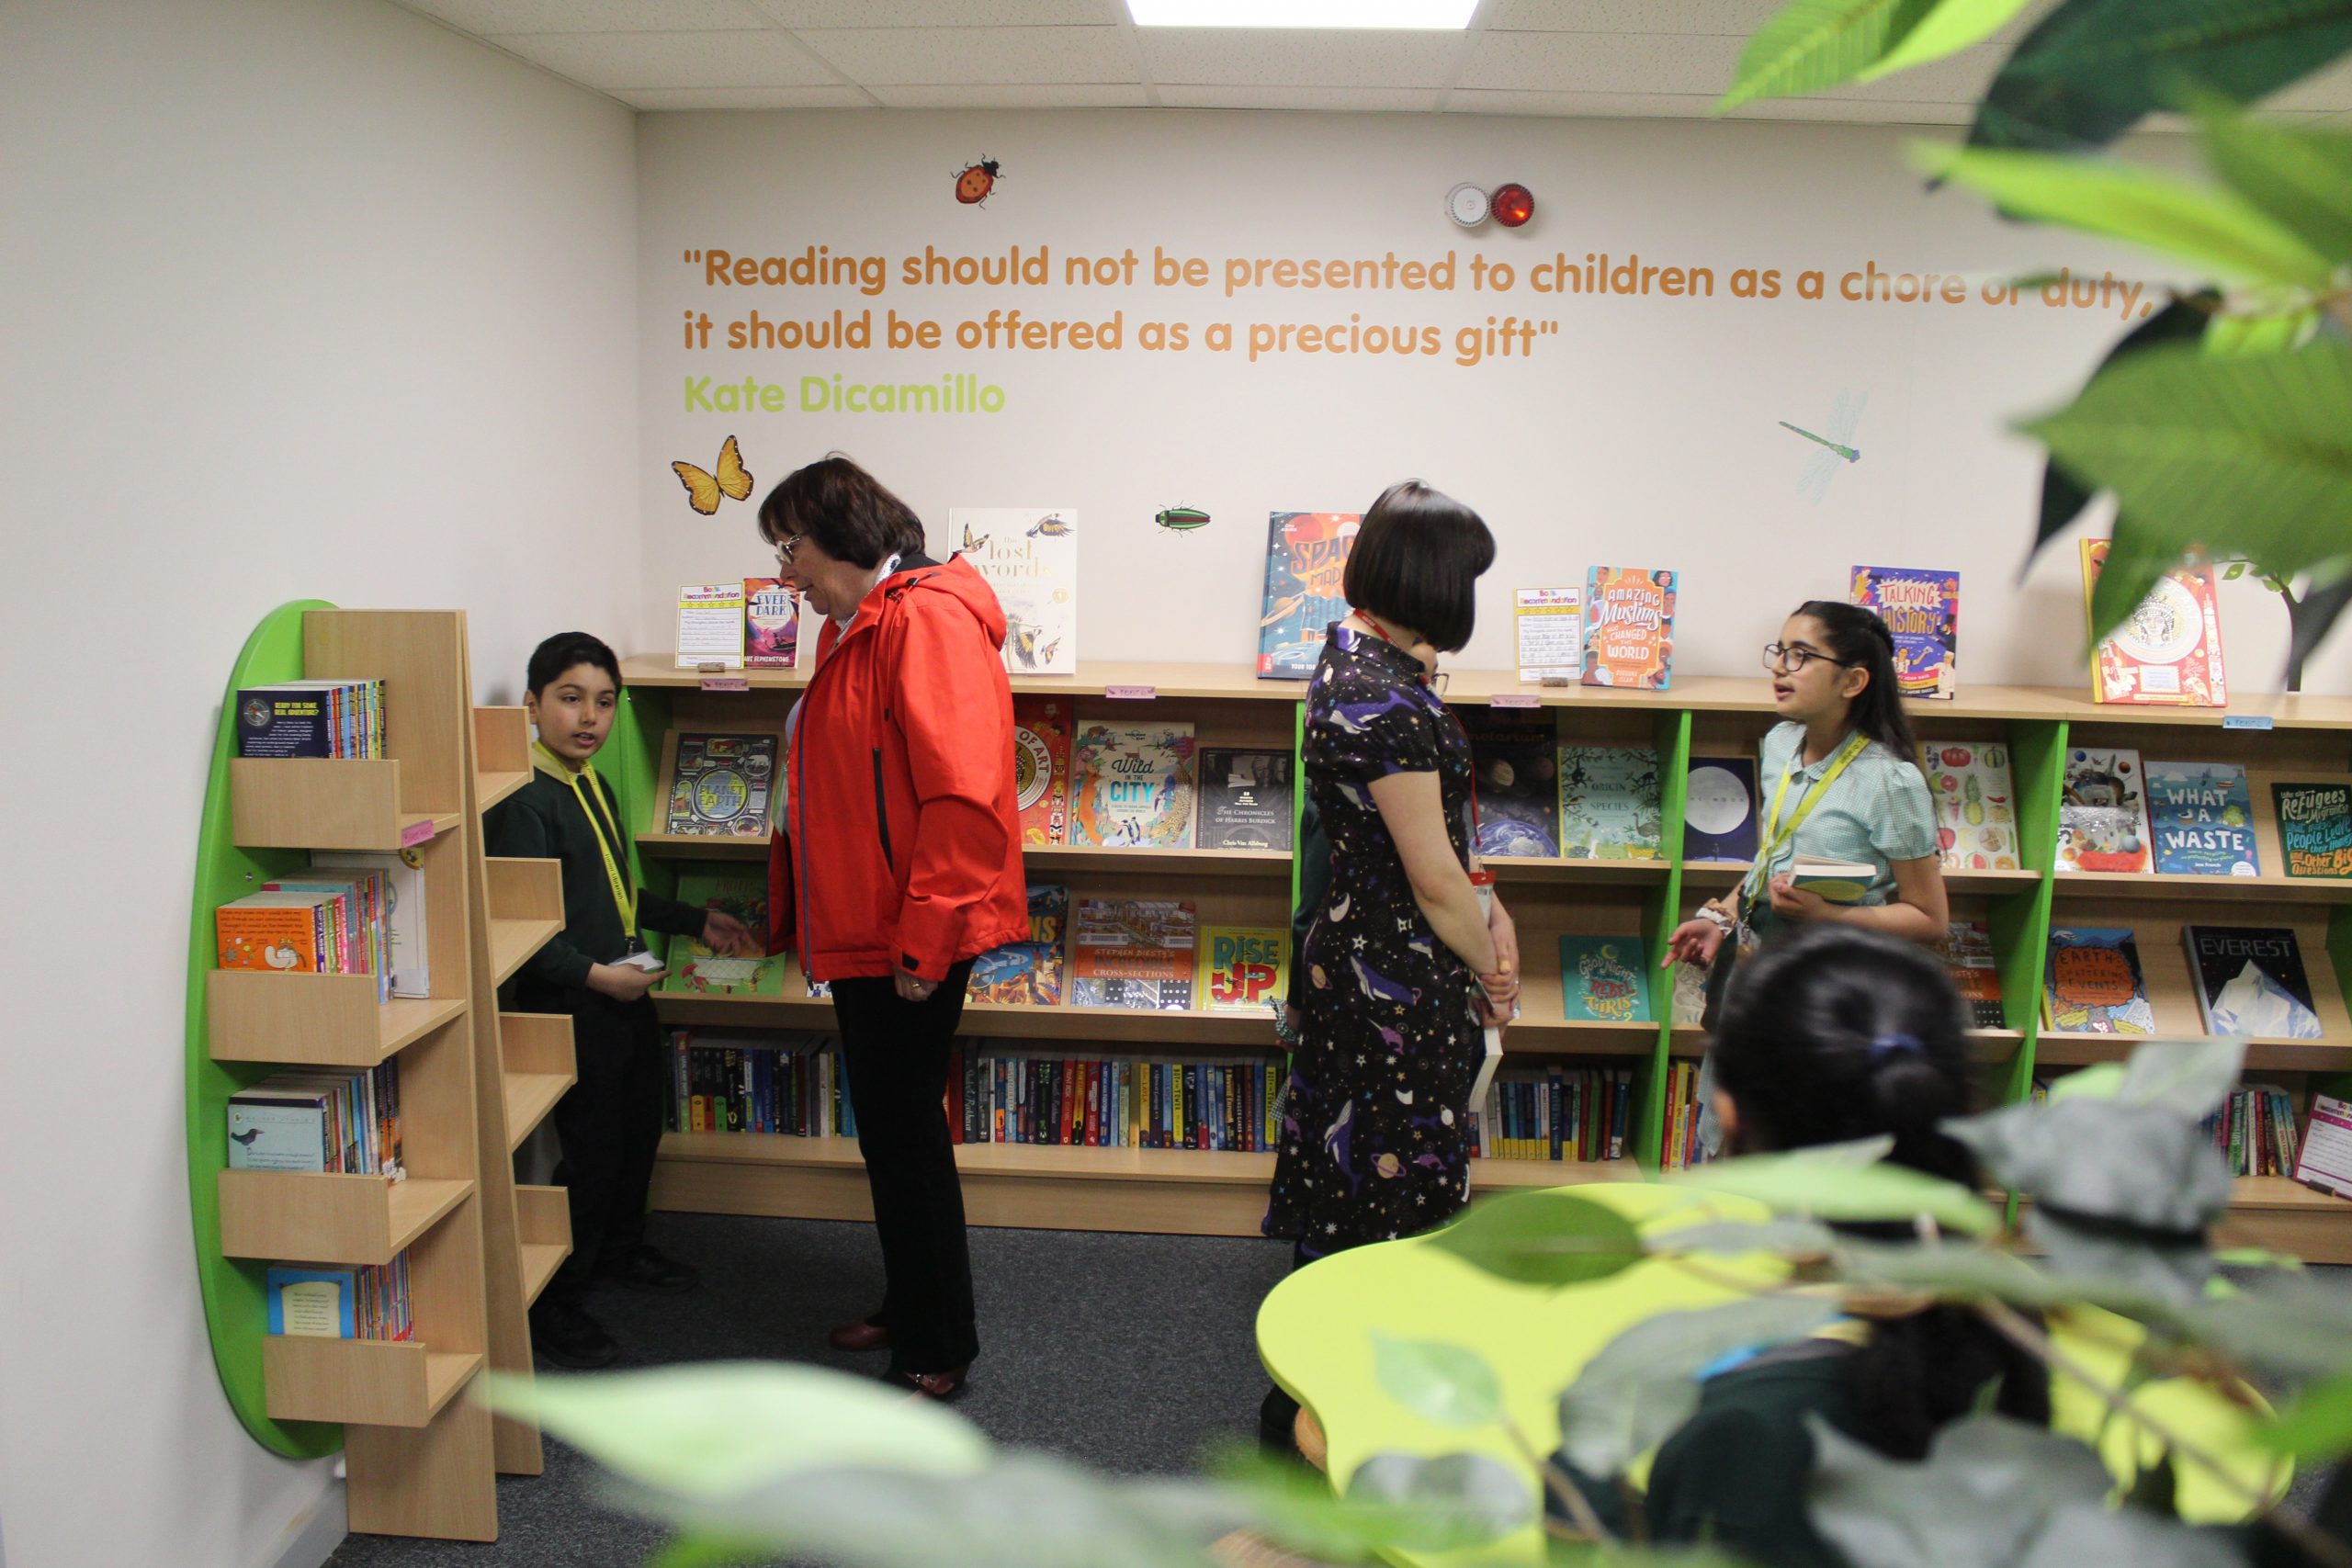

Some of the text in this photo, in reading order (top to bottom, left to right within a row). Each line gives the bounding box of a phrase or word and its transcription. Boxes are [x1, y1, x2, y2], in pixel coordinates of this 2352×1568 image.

[684, 245, 887, 296] "Reading
[901, 245, 1049, 286] should
[1065, 248, 1139, 286] not
[1153, 246, 1210, 287] be
[1225, 250, 1456, 298] presented
[1469, 254, 1516, 292] to
[1530, 252, 1713, 297] children
[1730, 266, 1781, 299] as
[1796, 268, 1825, 300] a
[1839, 261, 1967, 304] chore
[684, 310, 1558, 367] it should be offered as a precious gift"
[684, 373, 1005, 413] Kate Dicamillo
[989, 540, 1032, 560] lost
[1291, 536, 1356, 573] SPAC
[756, 594, 787, 605] EVER
[1880, 583, 1936, 605] TALKING
[755, 605, 787, 615] DARK
[1883, 609, 1937, 634] HISTORY
[1610, 629, 1647, 641] CHANGED
[1608, 645, 1649, 660] WORLD
[1033, 746, 1049, 773] ART
[1111, 758, 1155, 773] Wild
[1110, 781, 1155, 802] CITY
[2166, 788, 2228, 807] WHAT
[1590, 802, 1629, 811] SPECIES
[2198, 807, 2211, 822] A
[2165, 829, 2245, 851] WASTE
[2199, 938, 2291, 957] EVEREST
[1211, 963, 1276, 1004] UP
[1589, 978, 1635, 999] REBEL
